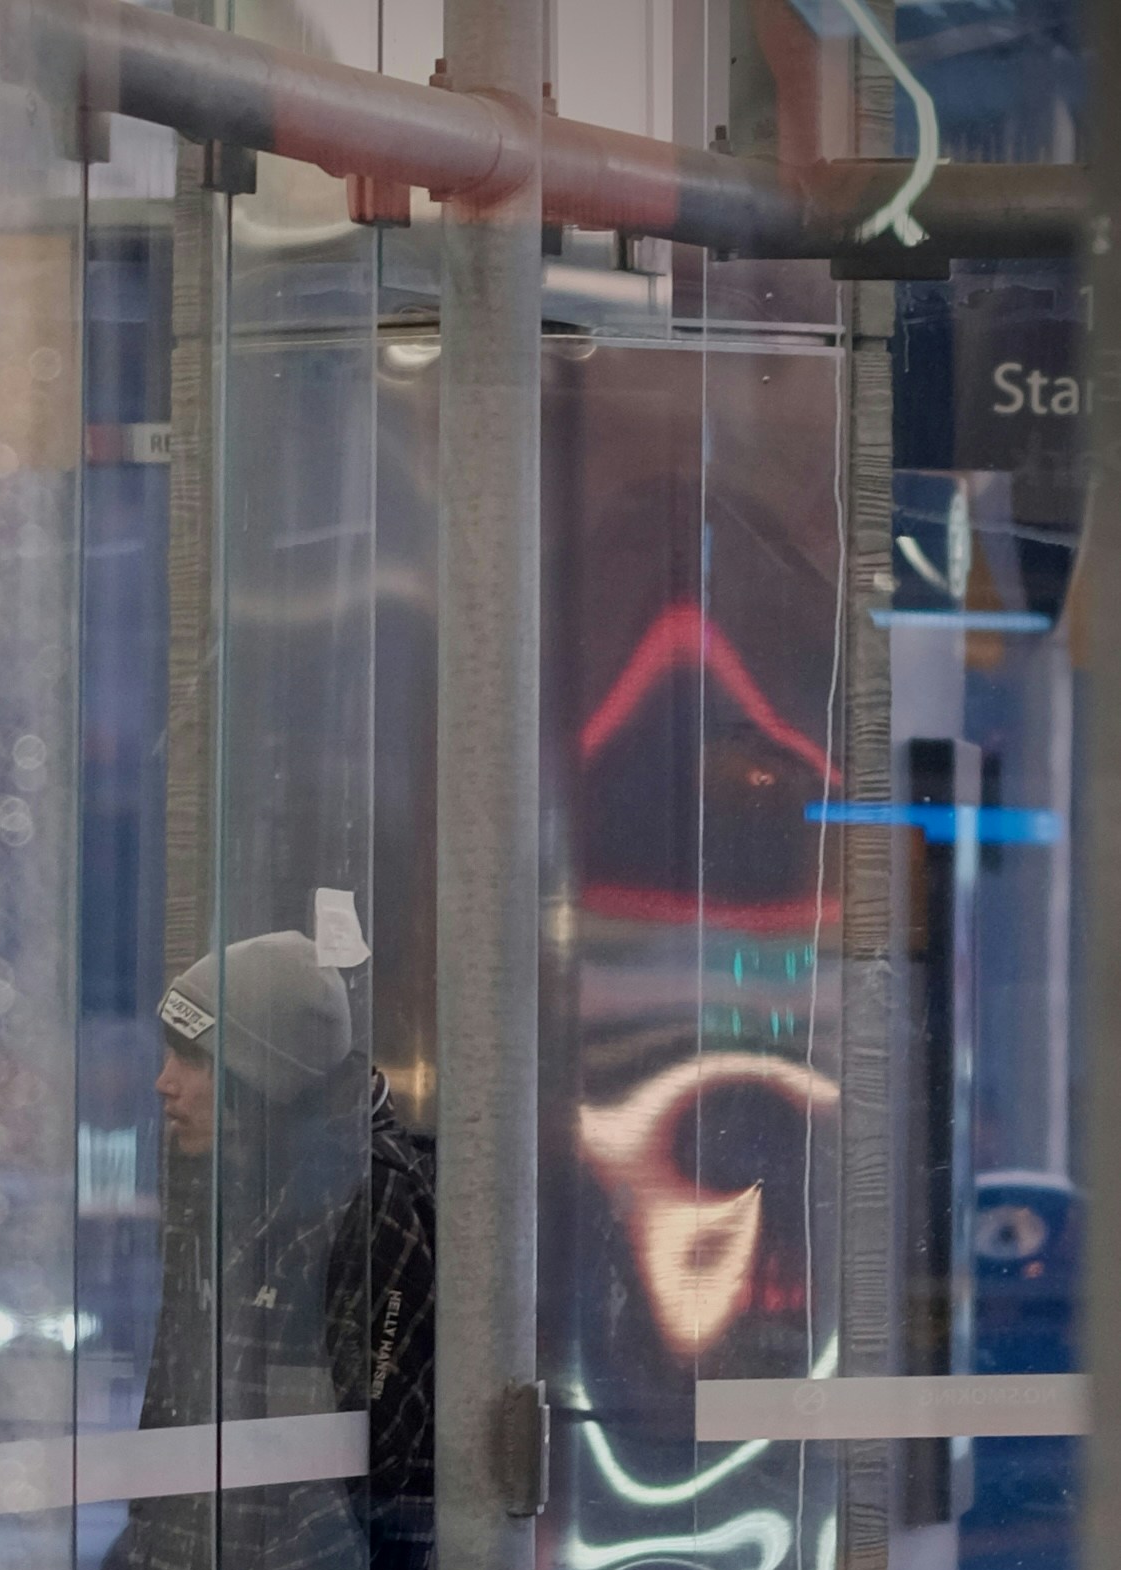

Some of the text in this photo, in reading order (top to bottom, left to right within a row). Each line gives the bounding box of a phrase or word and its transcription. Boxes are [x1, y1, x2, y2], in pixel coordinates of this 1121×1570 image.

[992, 361, 1095, 416] Sta
[371, 1289, 403, 1400] HELLY HANSEN
